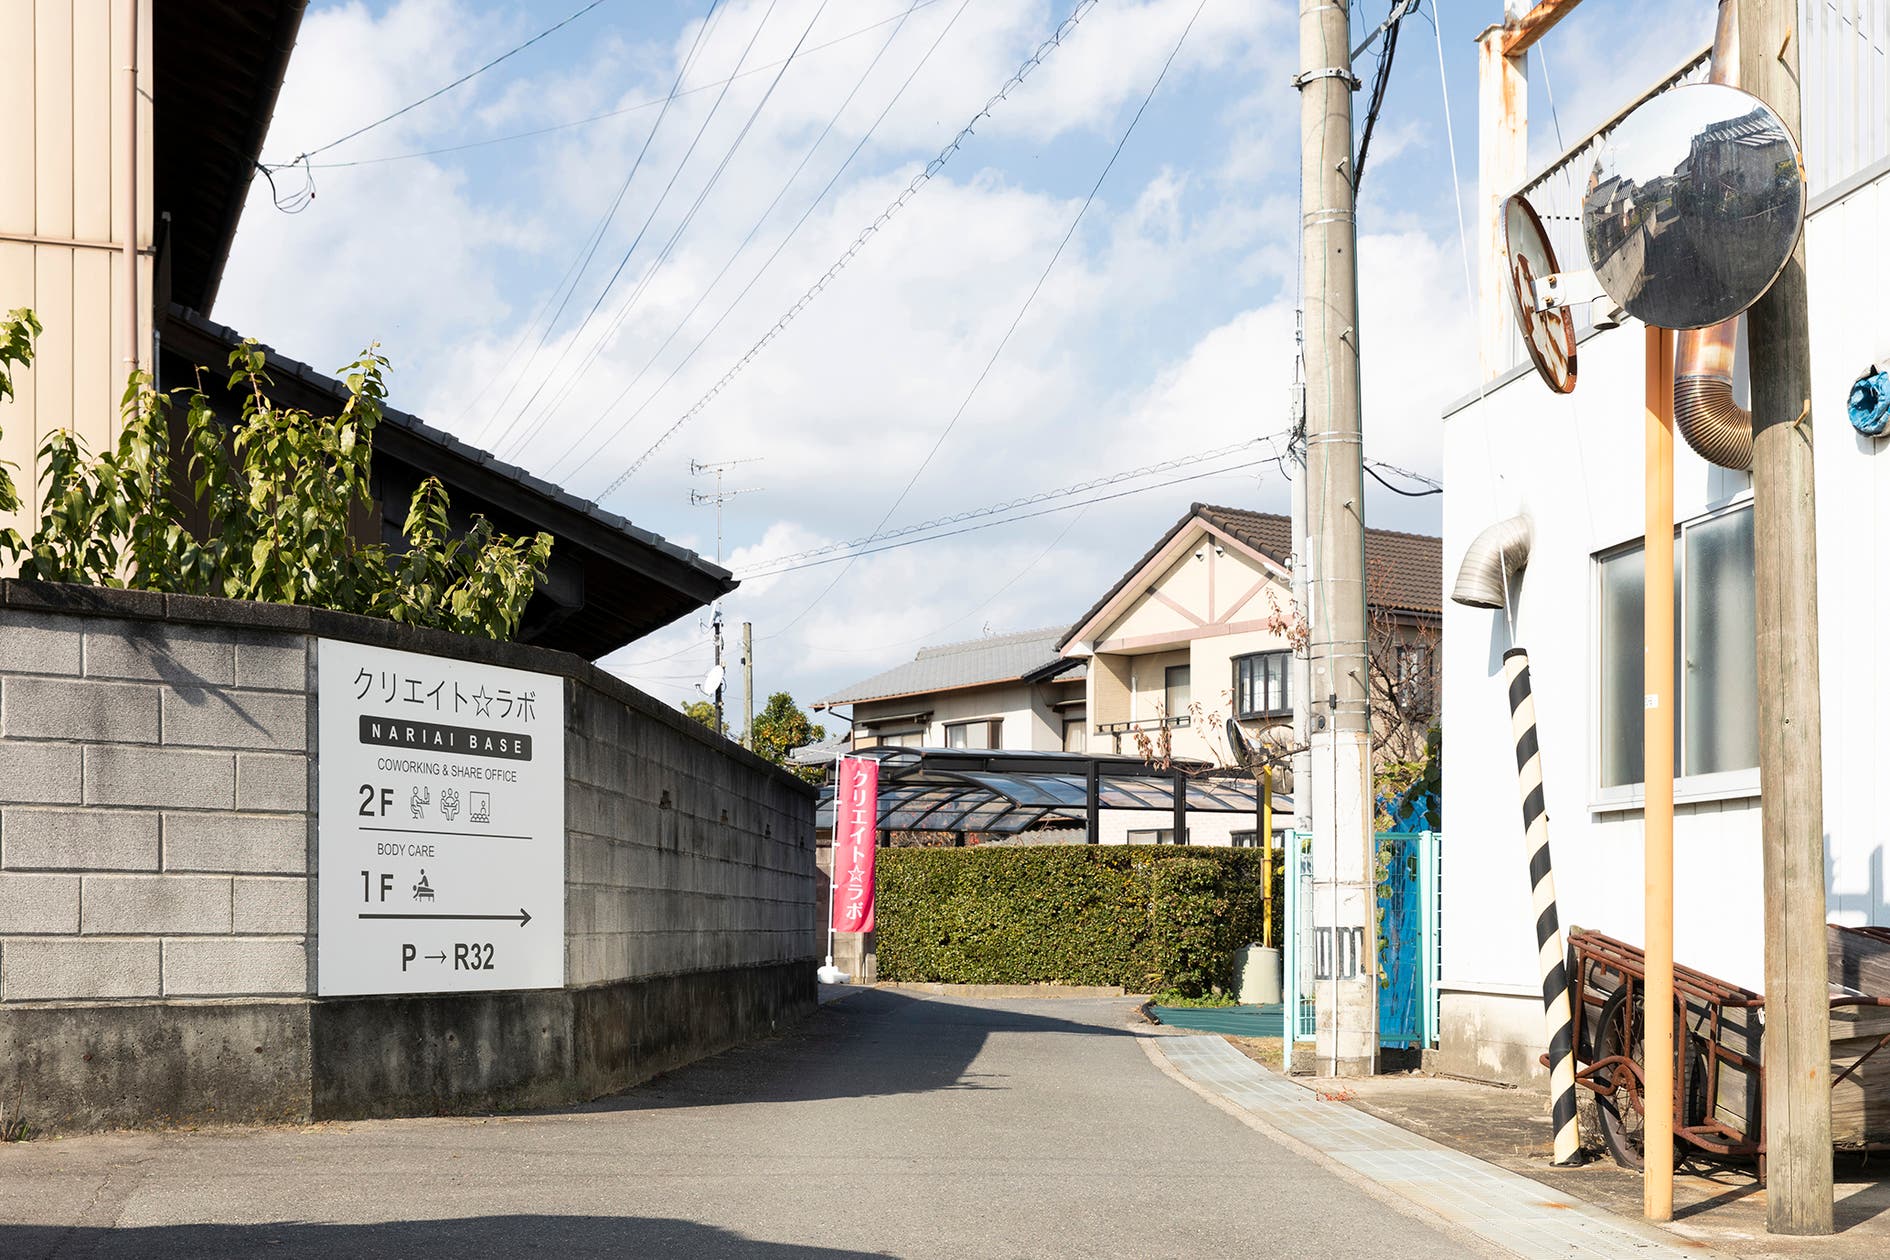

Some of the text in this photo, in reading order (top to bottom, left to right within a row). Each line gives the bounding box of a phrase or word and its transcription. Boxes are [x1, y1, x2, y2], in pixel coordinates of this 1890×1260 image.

[354, 667, 536, 722] クリエイト☆ラボ
[372, 723, 522, 754] NARIAI BASE
[377, 757, 517, 783] COWORKING & SHARE OFFICE
[358, 784, 394, 817] 2F
[377, 843, 435, 857] BODY CARE
[846, 770, 868, 920] クリエイト☆ラボ
[361, 870, 394, 902] 1F
[402, 943, 495, 972] P R32
